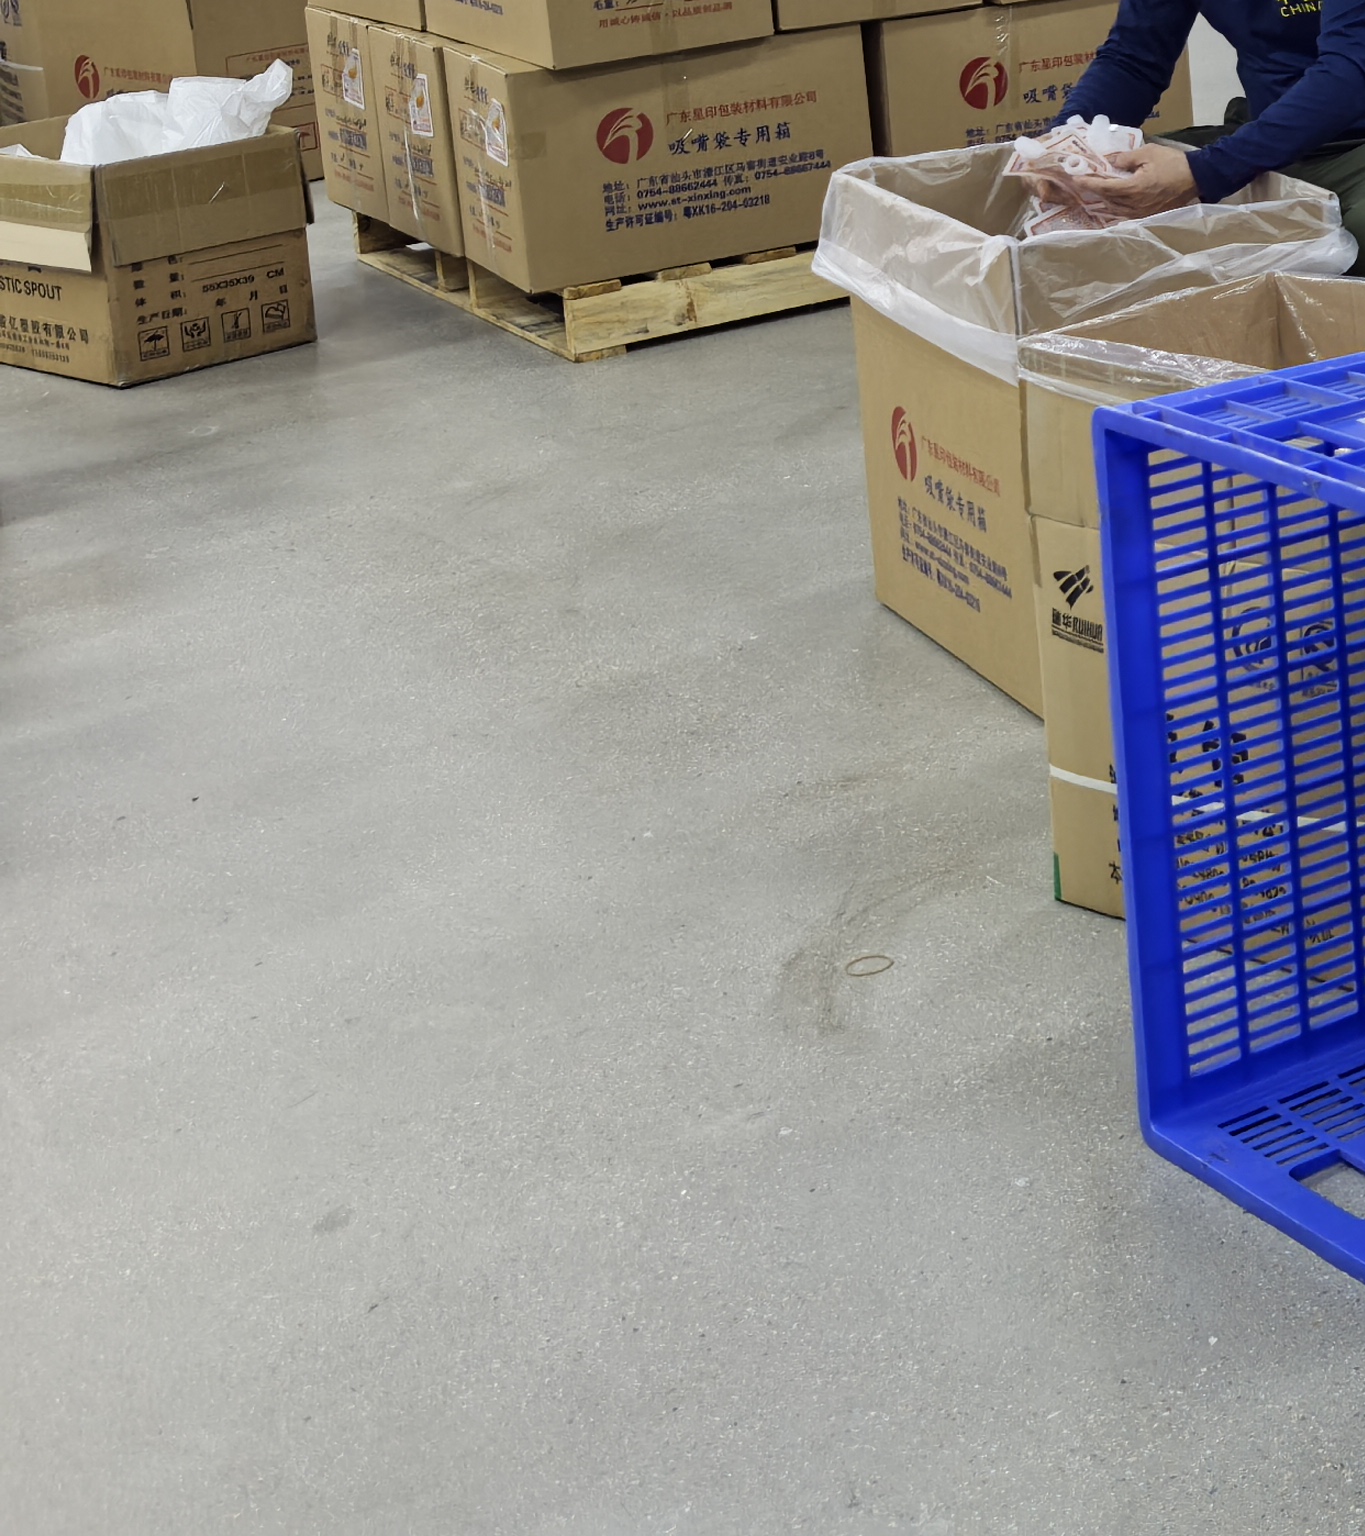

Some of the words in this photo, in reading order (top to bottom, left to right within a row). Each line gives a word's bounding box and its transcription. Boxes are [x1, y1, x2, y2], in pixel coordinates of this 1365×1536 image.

[668, 122, 791, 155] 吸嘴袋专用箱
[266, 267, 284, 279] CM
[24, 280, 62, 301] SPOUT
